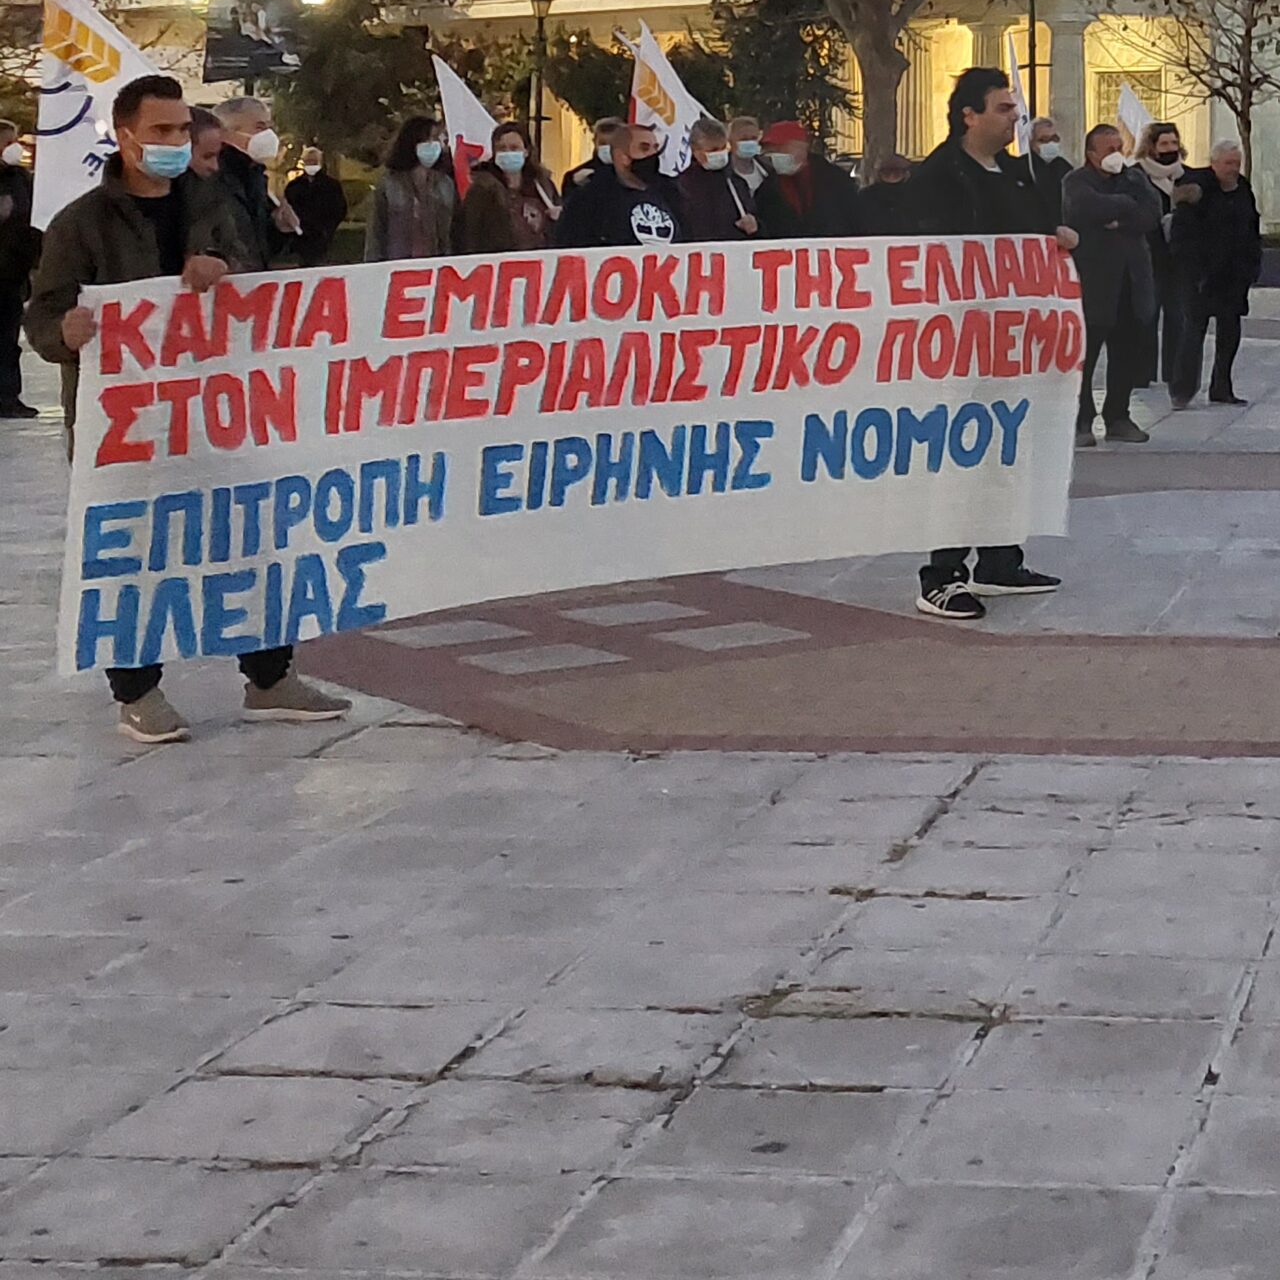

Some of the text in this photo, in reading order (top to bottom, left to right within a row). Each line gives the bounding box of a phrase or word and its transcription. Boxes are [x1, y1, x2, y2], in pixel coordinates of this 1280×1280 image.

[98, 276, 350, 376] ΚΑΜΙΑ
[381, 252, 726, 341] ΕΜΠΛΟΚΗ
[752, 247, 872, 313] ΤΗΣ
[94, 365, 298, 467] ΣΤΟΝ
[323, 321, 862, 436] ΙΜΠΕΡΙΑΛΙΣΤΙΚΟ
[81, 399, 1031, 581] ΕΠΙΤΡΟΠΗ ΕΙΡΗΝΗΣ ΝΟΜΟΥ
[75, 541, 388, 672] ΗΛΕΙΑΣ
